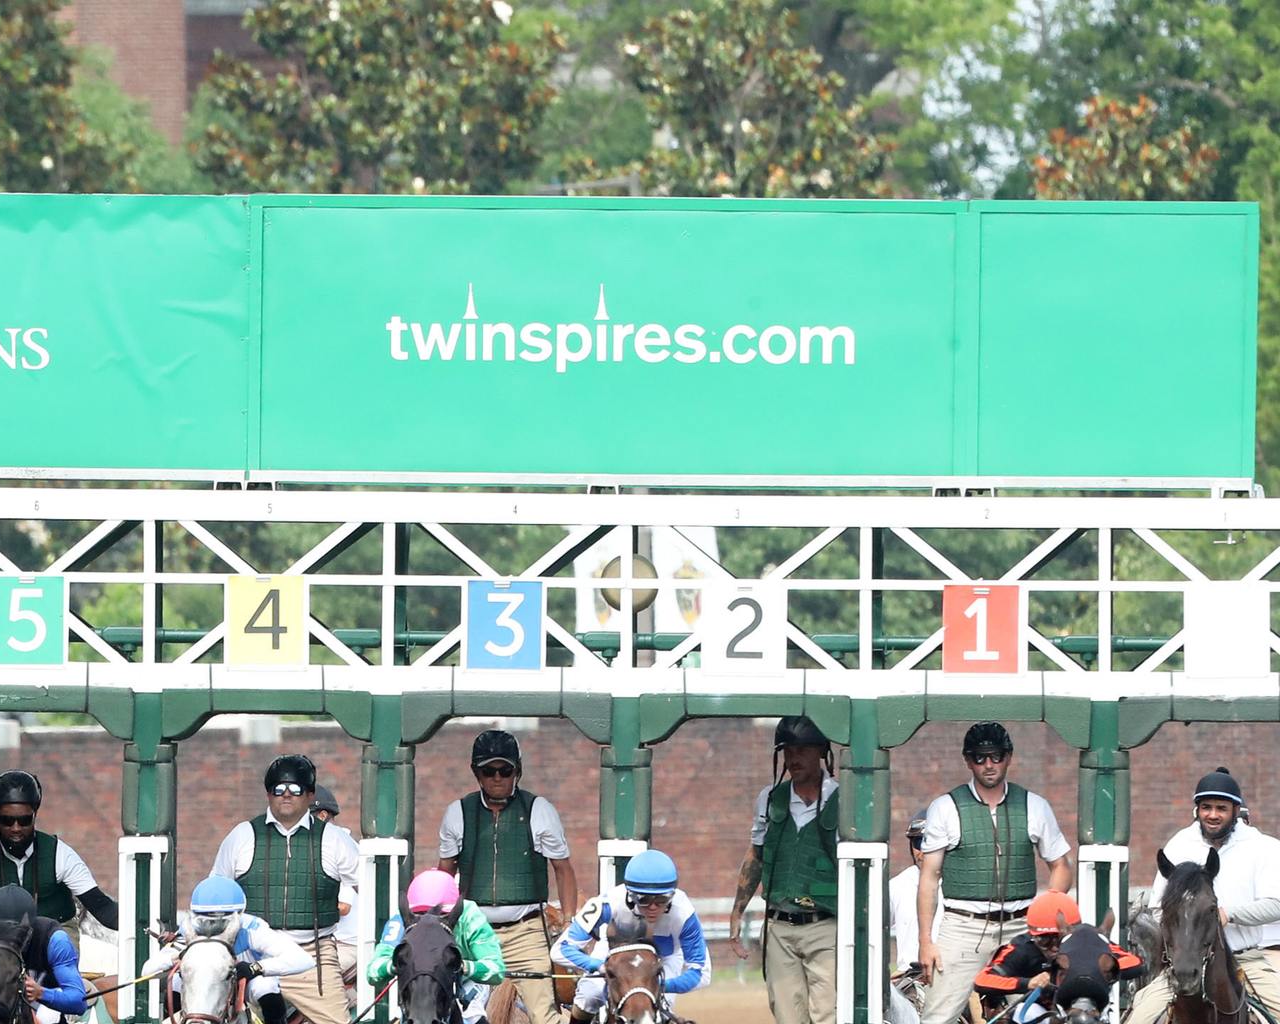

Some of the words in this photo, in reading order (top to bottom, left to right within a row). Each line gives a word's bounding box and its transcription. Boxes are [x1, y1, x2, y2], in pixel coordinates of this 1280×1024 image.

[385, 282, 856, 373] twinspires.com
[8, 588, 47, 653] 5
[244, 589, 288, 650] 4
[484, 592, 525, 658] 3
[726, 597, 763, 659] 2
[963, 597, 1000, 661] 1
[384, 920, 401, 942] 3
[582, 902, 598, 924] 2
